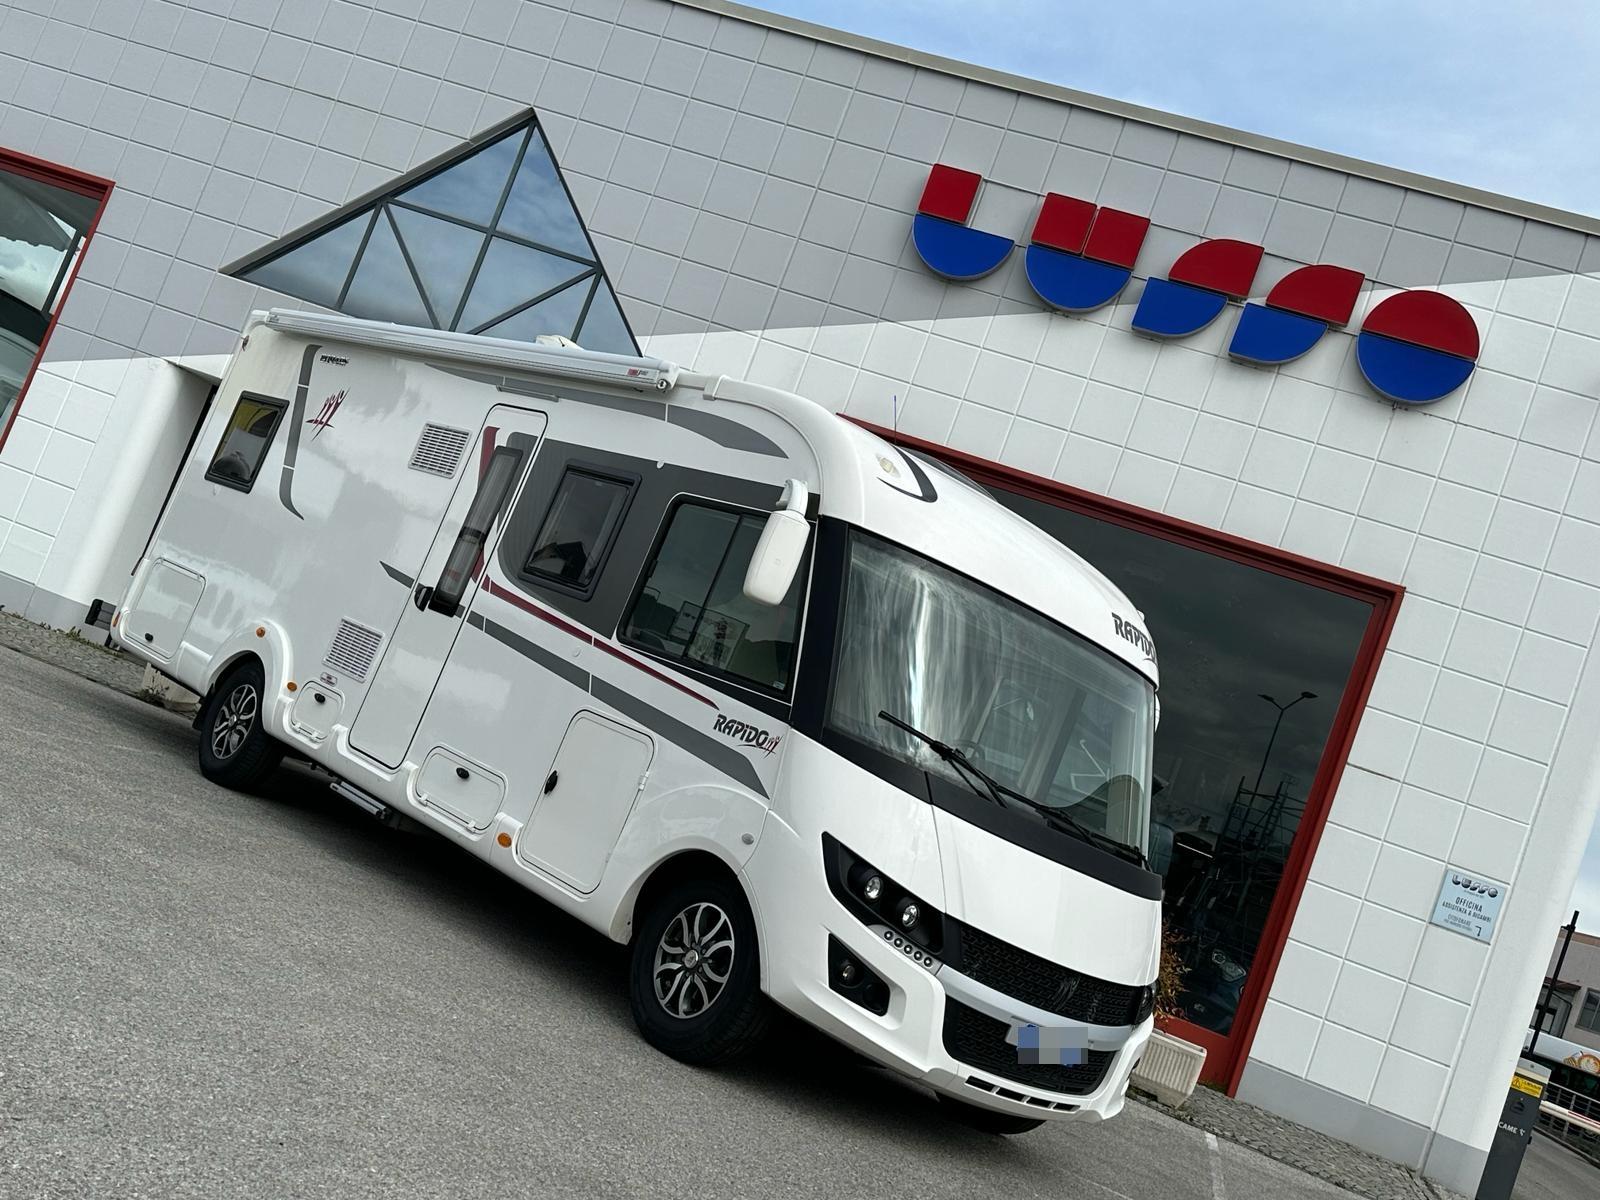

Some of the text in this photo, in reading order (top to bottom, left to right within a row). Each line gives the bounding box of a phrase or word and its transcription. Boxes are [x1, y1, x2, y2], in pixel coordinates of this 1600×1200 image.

[713, 713, 770, 747] RAPIDO
[1455, 896, 1483, 913] OFFICINA
[1498, 1121, 1518, 1134] CAME
